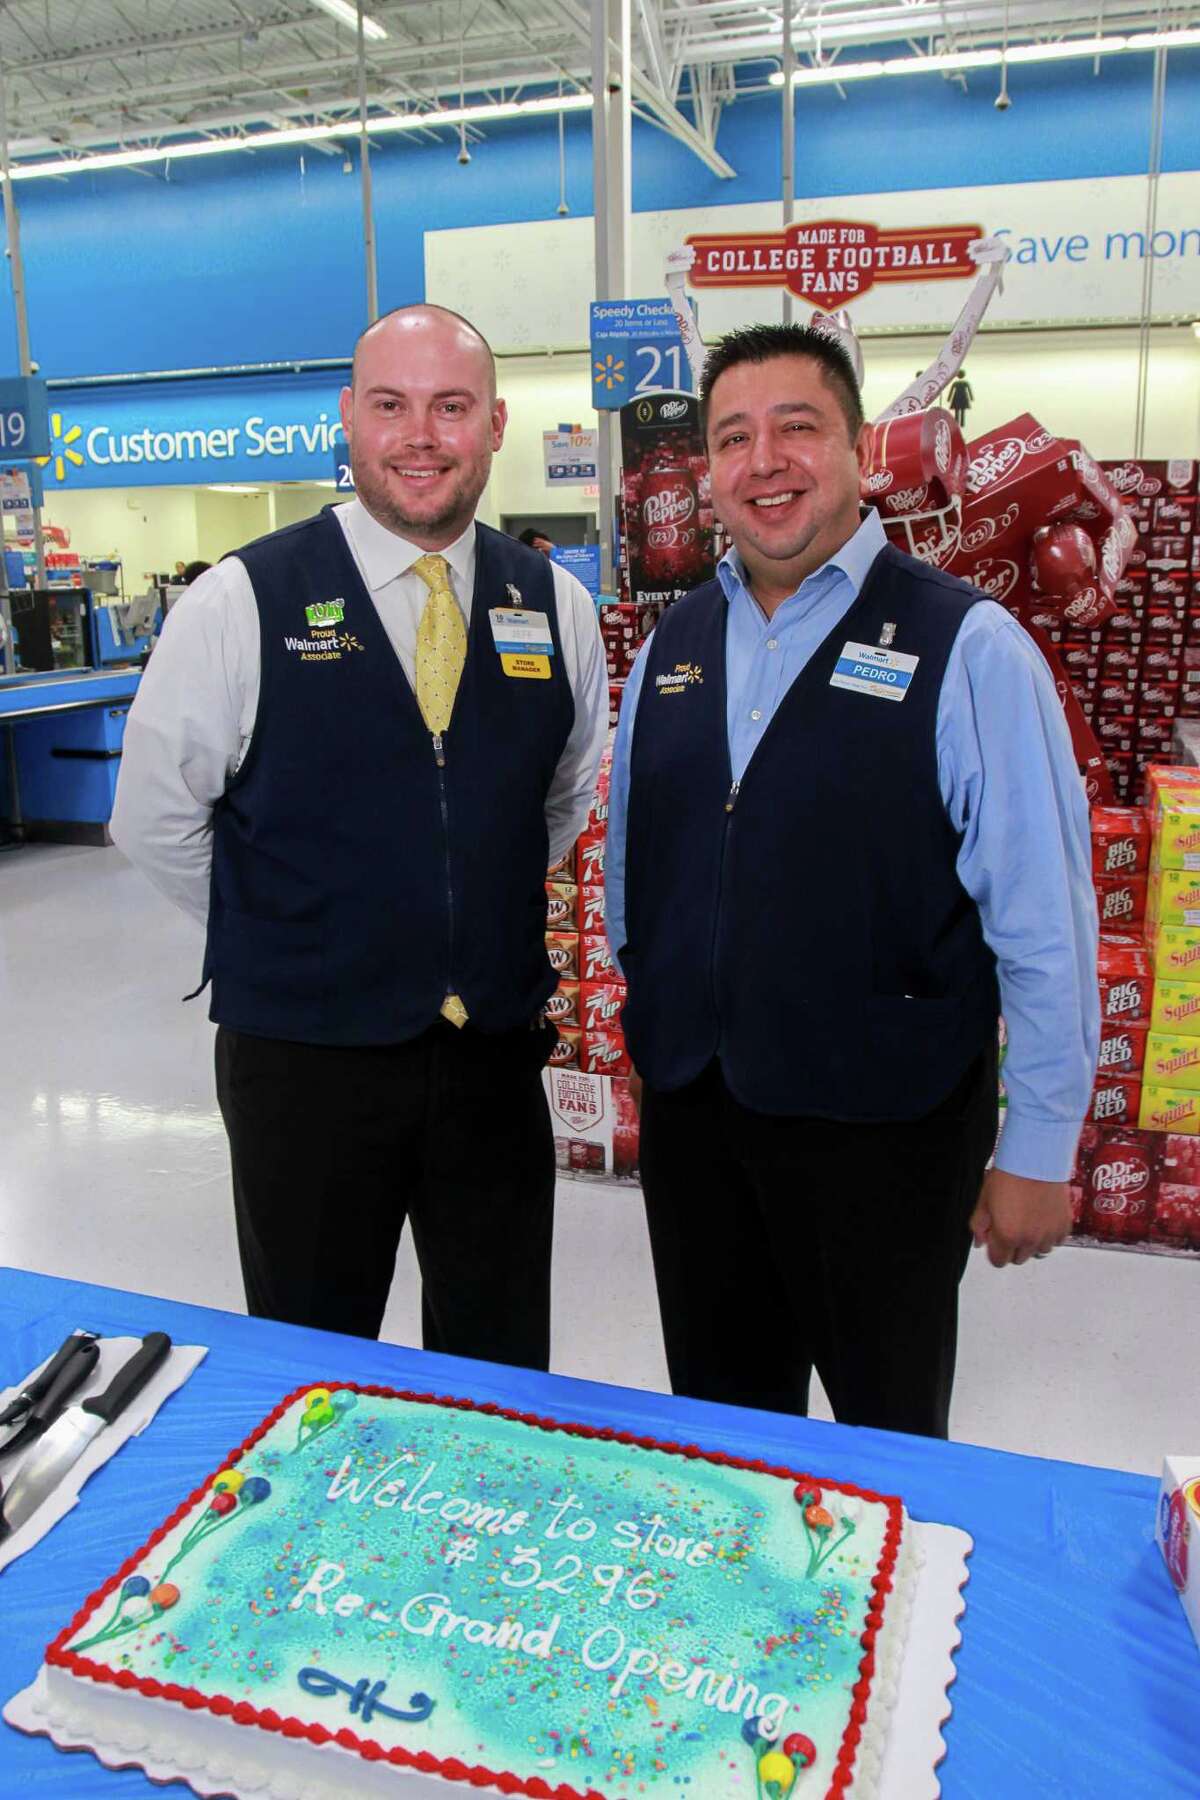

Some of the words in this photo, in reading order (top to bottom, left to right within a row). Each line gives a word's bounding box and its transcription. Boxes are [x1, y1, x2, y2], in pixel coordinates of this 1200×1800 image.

[797, 229, 836, 245] MADE
[839, 228, 865, 243] FOR
[707, 248, 816, 272] COLLEGE
[826, 242, 958, 270] FOOTBALL
[801, 271, 860, 293] FANS
[593, 304, 635, 319] Speedy
[635, 345, 680, 392] 21
[86, 426, 241, 465] Customer
[970, 450, 997, 474] Dr
[659, 490, 680, 508] Dr
[645, 496, 691, 526] Pepper
[636, 591, 671, 603] EVERY
[284, 636, 340, 651] Walmart
[311, 629, 337, 639] Proud
[301, 651, 342, 661] Associate
[858, 651, 890, 664] Walmart
[853, 664, 897, 683] PEDRO
[1107, 837, 1133, 859] BIG
[1105, 850, 1137, 871] RED
[1105, 887, 1130, 907] BIG
[1103, 899, 1134, 920] RED
[1109, 980, 1138, 1002] BIG
[1106, 993, 1141, 1016] RED
[1100, 1034, 1129, 1055] BIG
[1099, 1047, 1133, 1067] RED
[1156, 1048, 1198, 1075] Squirt
[557, 1079, 597, 1095] COLLEGE
[1095, 1085, 1124, 1106] BIG
[559, 1098, 598, 1115] FANS
[1093, 1098, 1127, 1120] RED
[1151, 1099, 1194, 1128] Squirt
[1095, 1164, 1147, 1192] Pepper
[1112, 1161, 1135, 1177] Dr
[327, 1453, 527, 1537] Welcome
[544, 1493, 598, 1542] to
[611, 1511, 714, 1567] store
[444, 1535, 478, 1567] #
[499, 1545, 658, 1611] 3296
[581, 1626, 790, 1741] Opening
